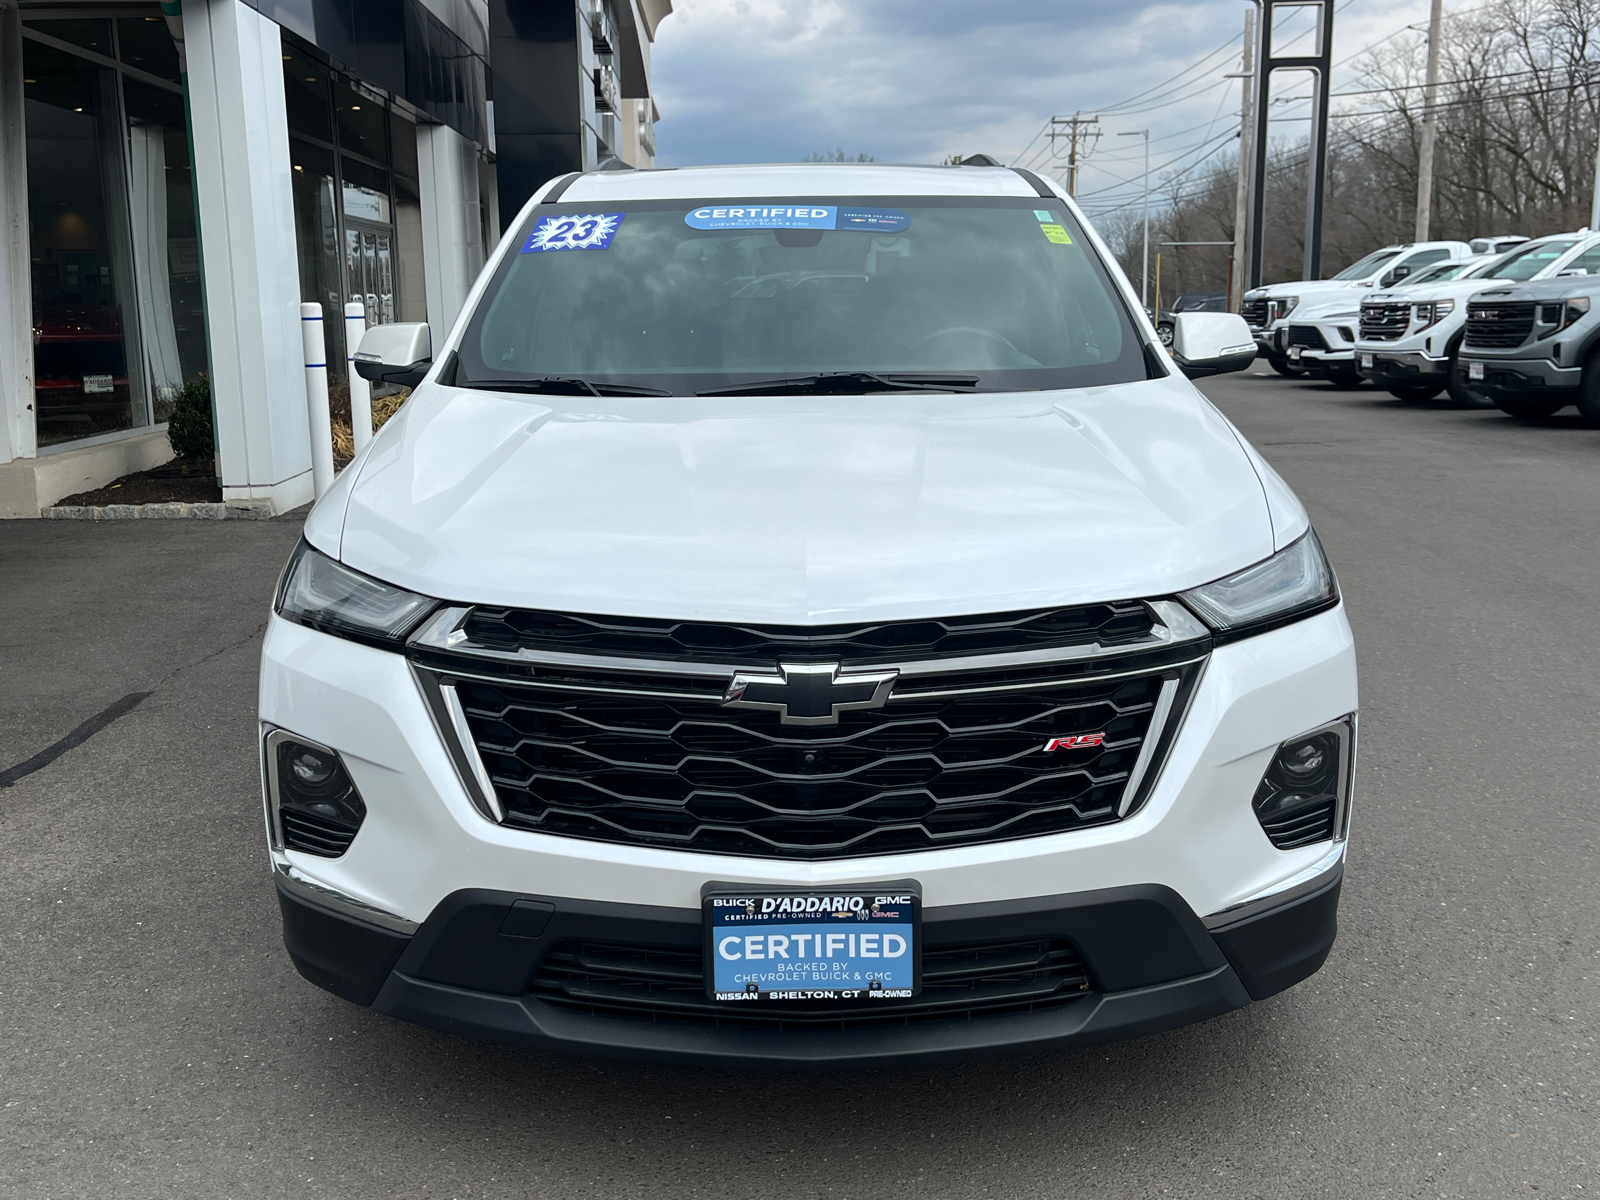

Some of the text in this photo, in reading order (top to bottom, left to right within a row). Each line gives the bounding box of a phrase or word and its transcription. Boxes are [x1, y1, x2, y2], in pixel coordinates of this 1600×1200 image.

[694, 208, 828, 218] CERTIFIED
[546, 219, 601, 244] 23
[1043, 732, 1105, 751] RS
[713, 899, 755, 907] BUICK
[761, 896, 864, 913] D'ADDARIO
[874, 896, 911, 904] GMC
[719, 934, 906, 960] CERTIFIED
[777, 962, 848, 972] BACKED BY
[734, 971, 892, 983] CHEVROLET BUICK & GMC
[716, 992, 758, 1001] NISSAN
[769, 990, 860, 1000] SHELTON, CT
[869, 989, 912, 998] PRE-OWNED
